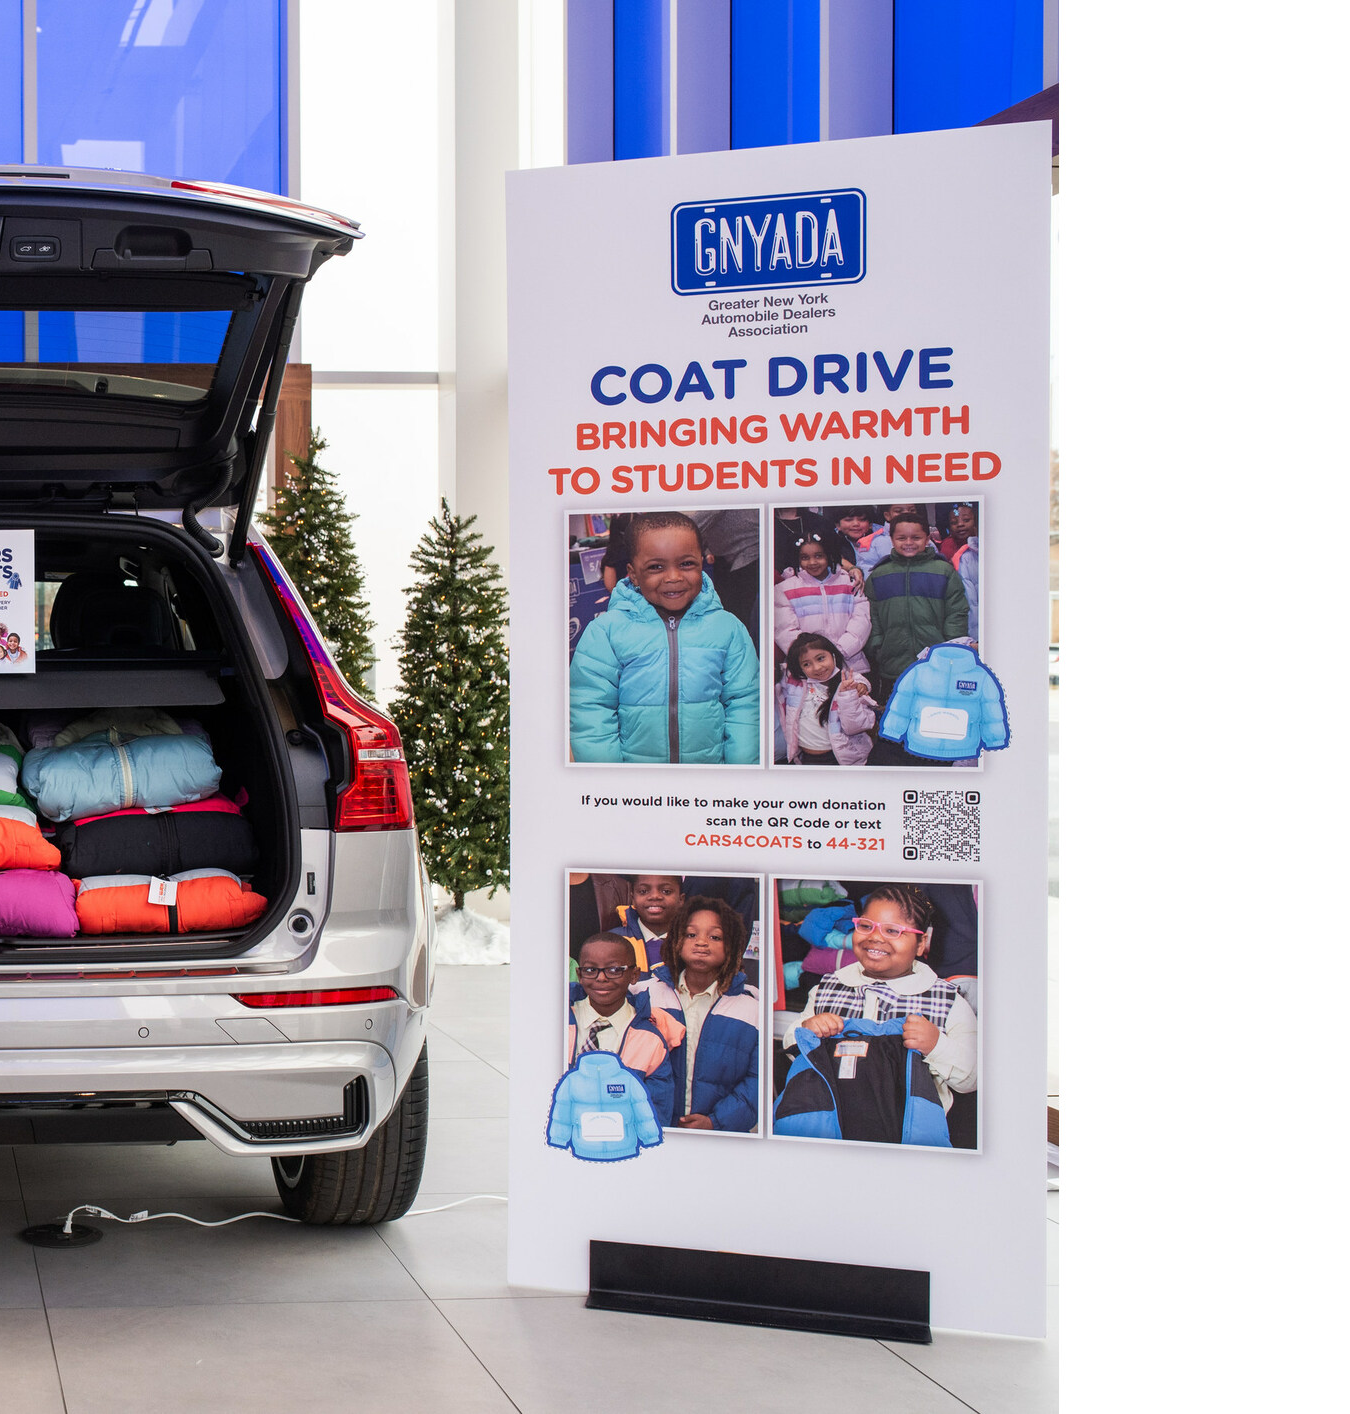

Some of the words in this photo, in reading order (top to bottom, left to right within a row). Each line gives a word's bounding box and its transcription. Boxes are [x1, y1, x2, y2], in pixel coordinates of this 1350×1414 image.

[695, 209, 844, 276] GNYADA
[709, 299, 759, 311] Greater
[764, 296, 794, 307] New
[798, 293, 828, 304] York
[702, 310, 779, 326] Automobile
[784, 308, 835, 319] Dealers
[728, 323, 807, 337] Association
[591, 359, 747, 406] COAT
[769, 347, 953, 397] DRIVE
[577, 415, 768, 450] BRINGING
[780, 405, 969, 442] WARMTH
[548, 467, 600, 495] TO
[611, 458, 818, 493] STUDENTS
[832, 456, 871, 486] IN
[886, 451, 1001, 484] NEED
[582, 795, 590, 805] If
[594, 798, 617, 807] you
[622, 796, 662, 806] would
[667, 797, 689, 807] like
[694, 798, 708, 807] to
[713, 798, 749, 808] make
[754, 801, 784, 810] your
[789, 801, 817, 809] own
[822, 799, 885, 810] donation
[706, 818, 736, 826] scan
[741, 817, 763, 827] the
[768, 817, 788, 827] QR
[794, 818, 830, 828] Code
[854, 819, 881, 829] text
[685, 834, 802, 848] CARS4COATS
[807, 839, 821, 849] to
[826, 837, 884, 850] 44-321
